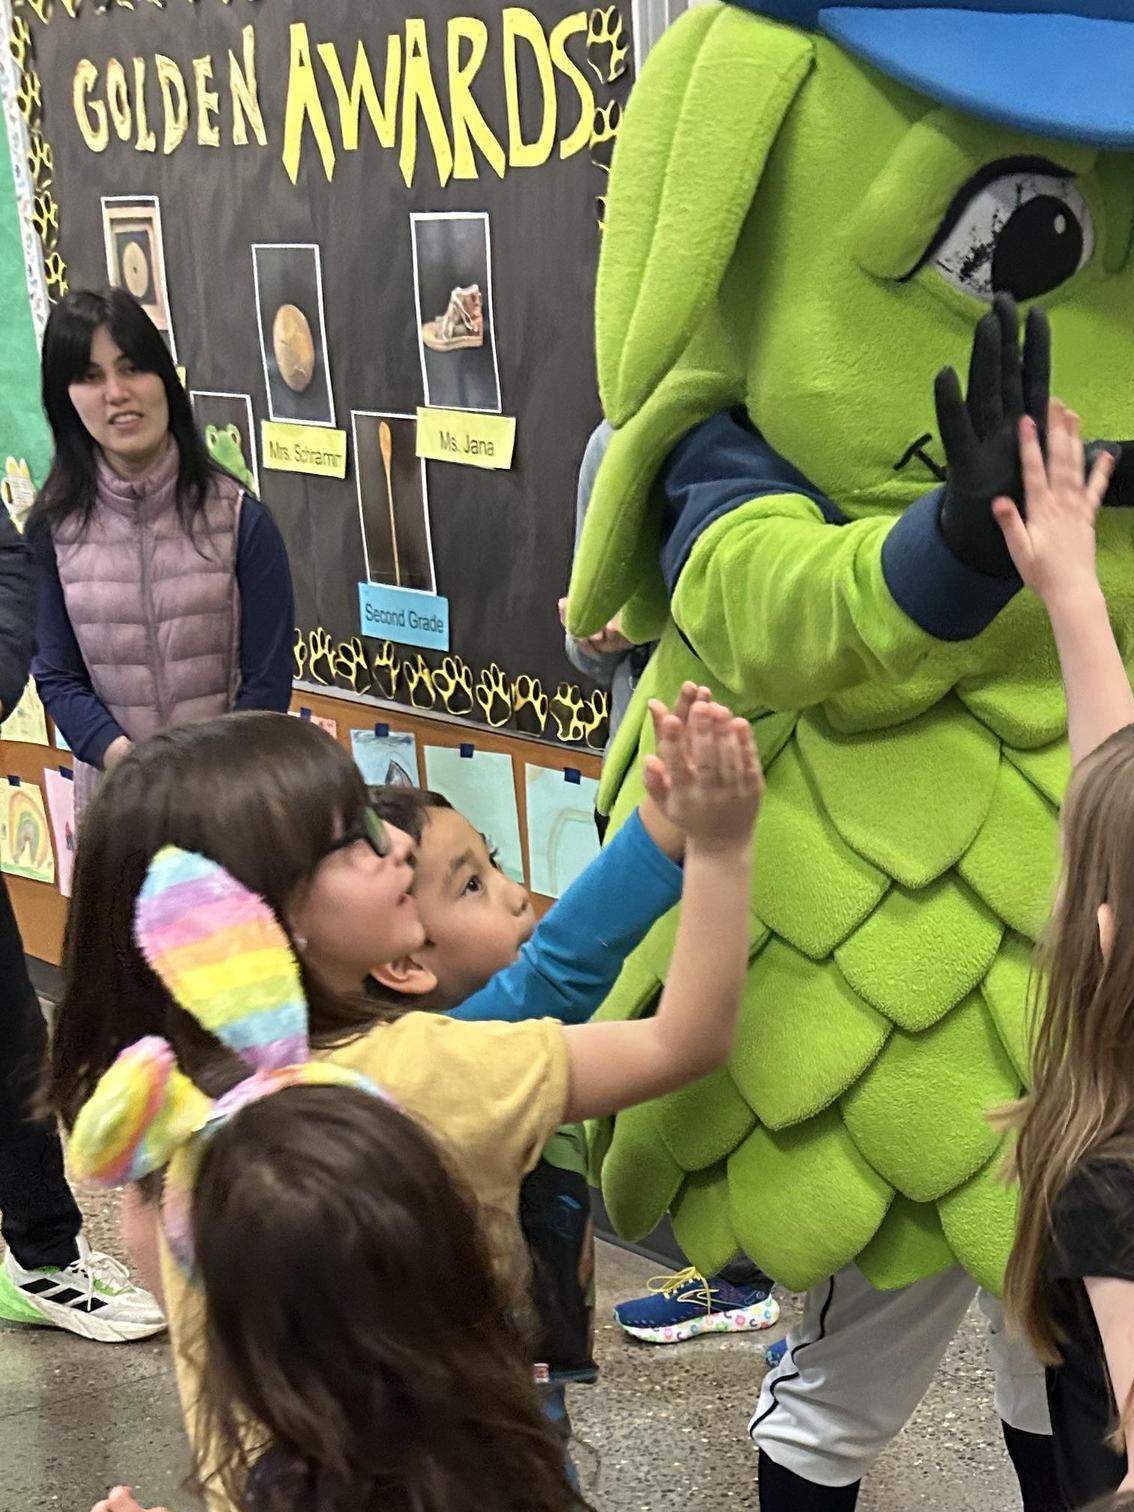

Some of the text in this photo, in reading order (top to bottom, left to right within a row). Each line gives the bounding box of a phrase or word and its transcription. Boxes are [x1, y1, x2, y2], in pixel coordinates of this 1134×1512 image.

[73, 7, 595, 188] GOLDEN AWARDS
[269, 440, 291, 461] Mrs.
[440, 430, 494, 456] Ms. Jana
[365, 602, 444, 634] Second Grade
